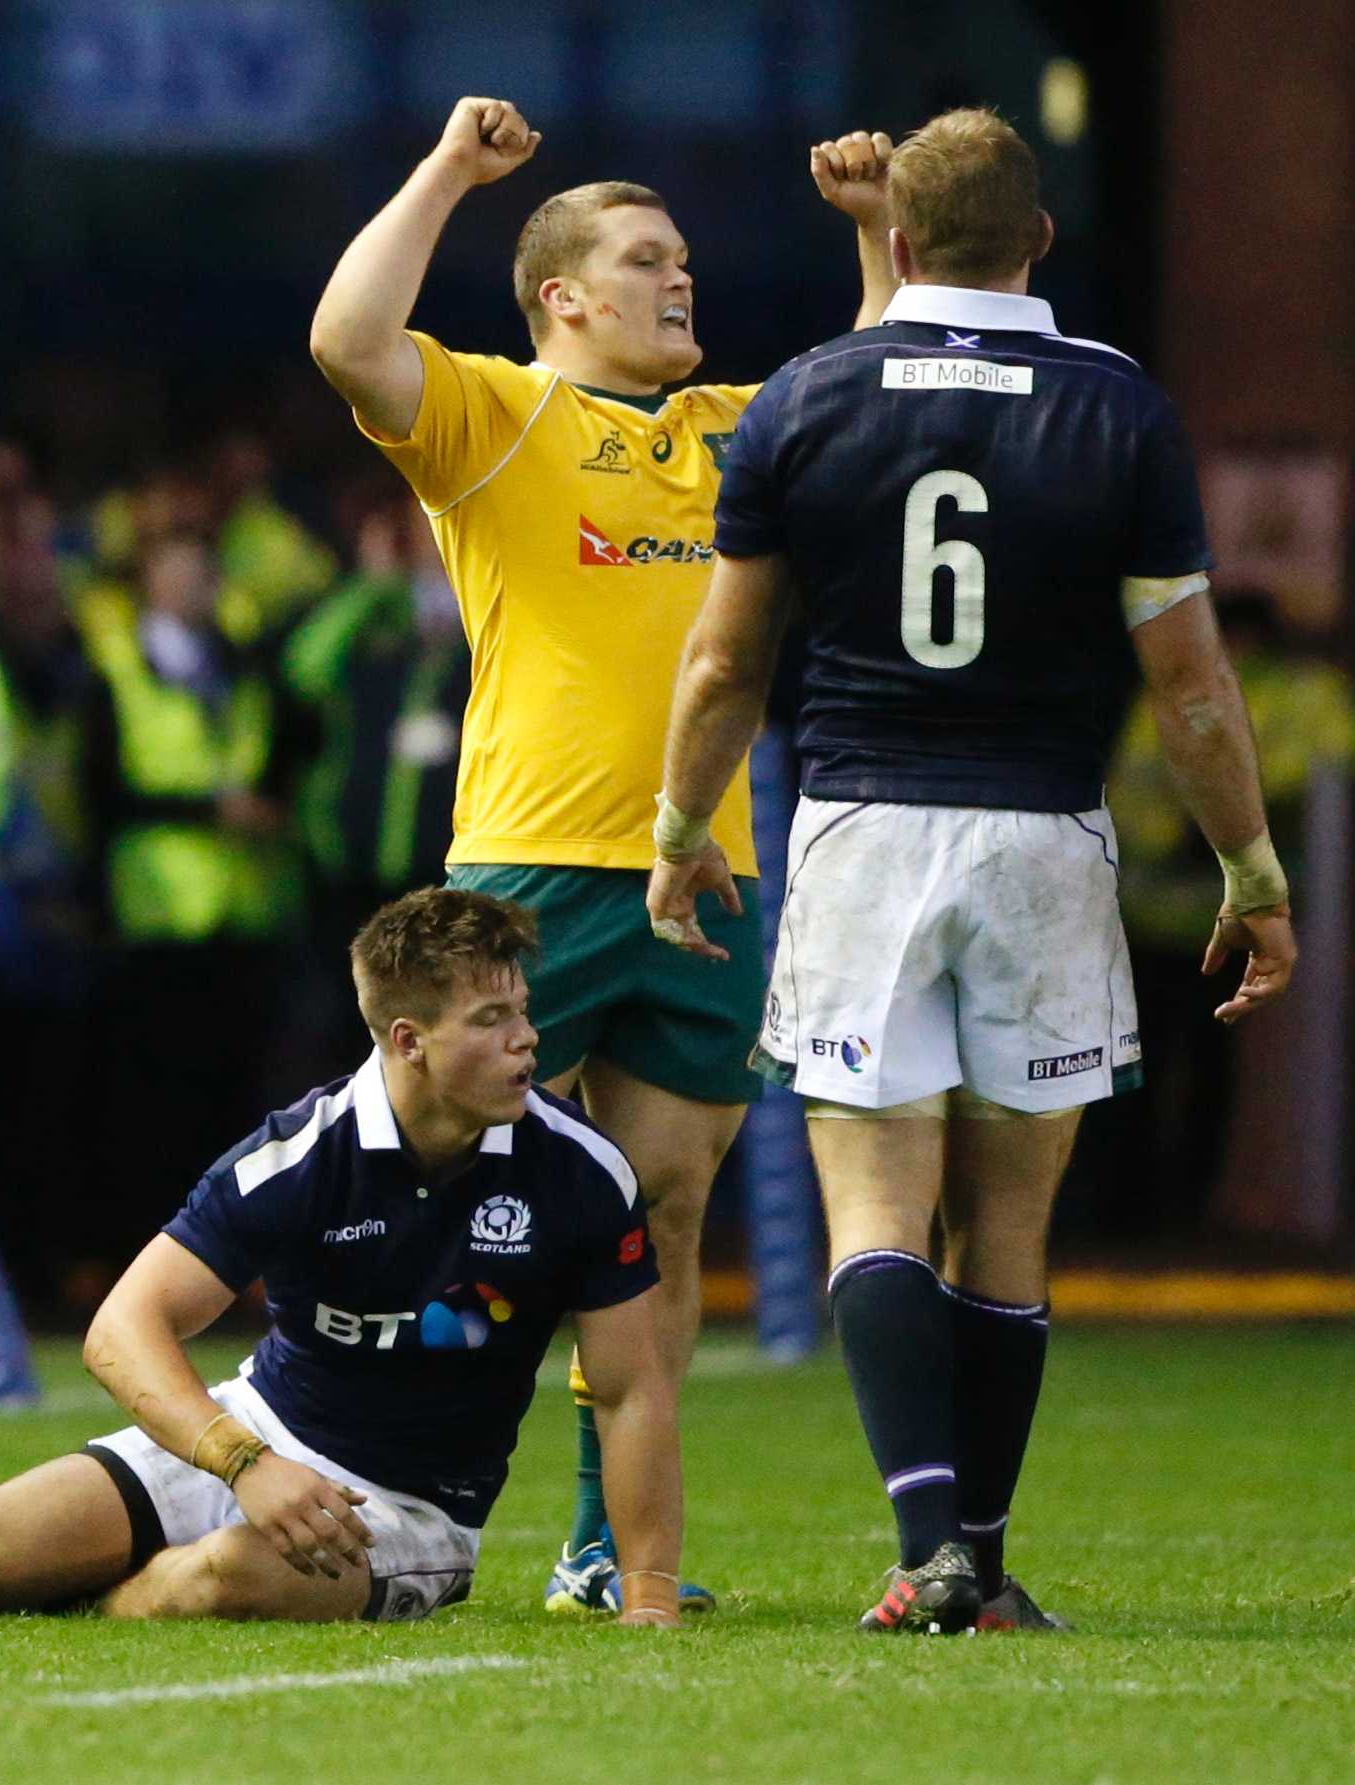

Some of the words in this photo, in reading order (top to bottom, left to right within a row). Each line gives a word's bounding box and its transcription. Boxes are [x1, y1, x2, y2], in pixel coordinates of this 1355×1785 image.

[902, 362, 931, 384] BT
[937, 362, 1014, 389] Mobile
[900, 469, 989, 669] 6
[811, 1037, 839, 1058] BT
[1032, 1060, 1055, 1079] BT
[1055, 1050, 1100, 1077] Mobile
[470, 1242, 532, 1254] SCOTLAND
[314, 1302, 417, 1350] BT
